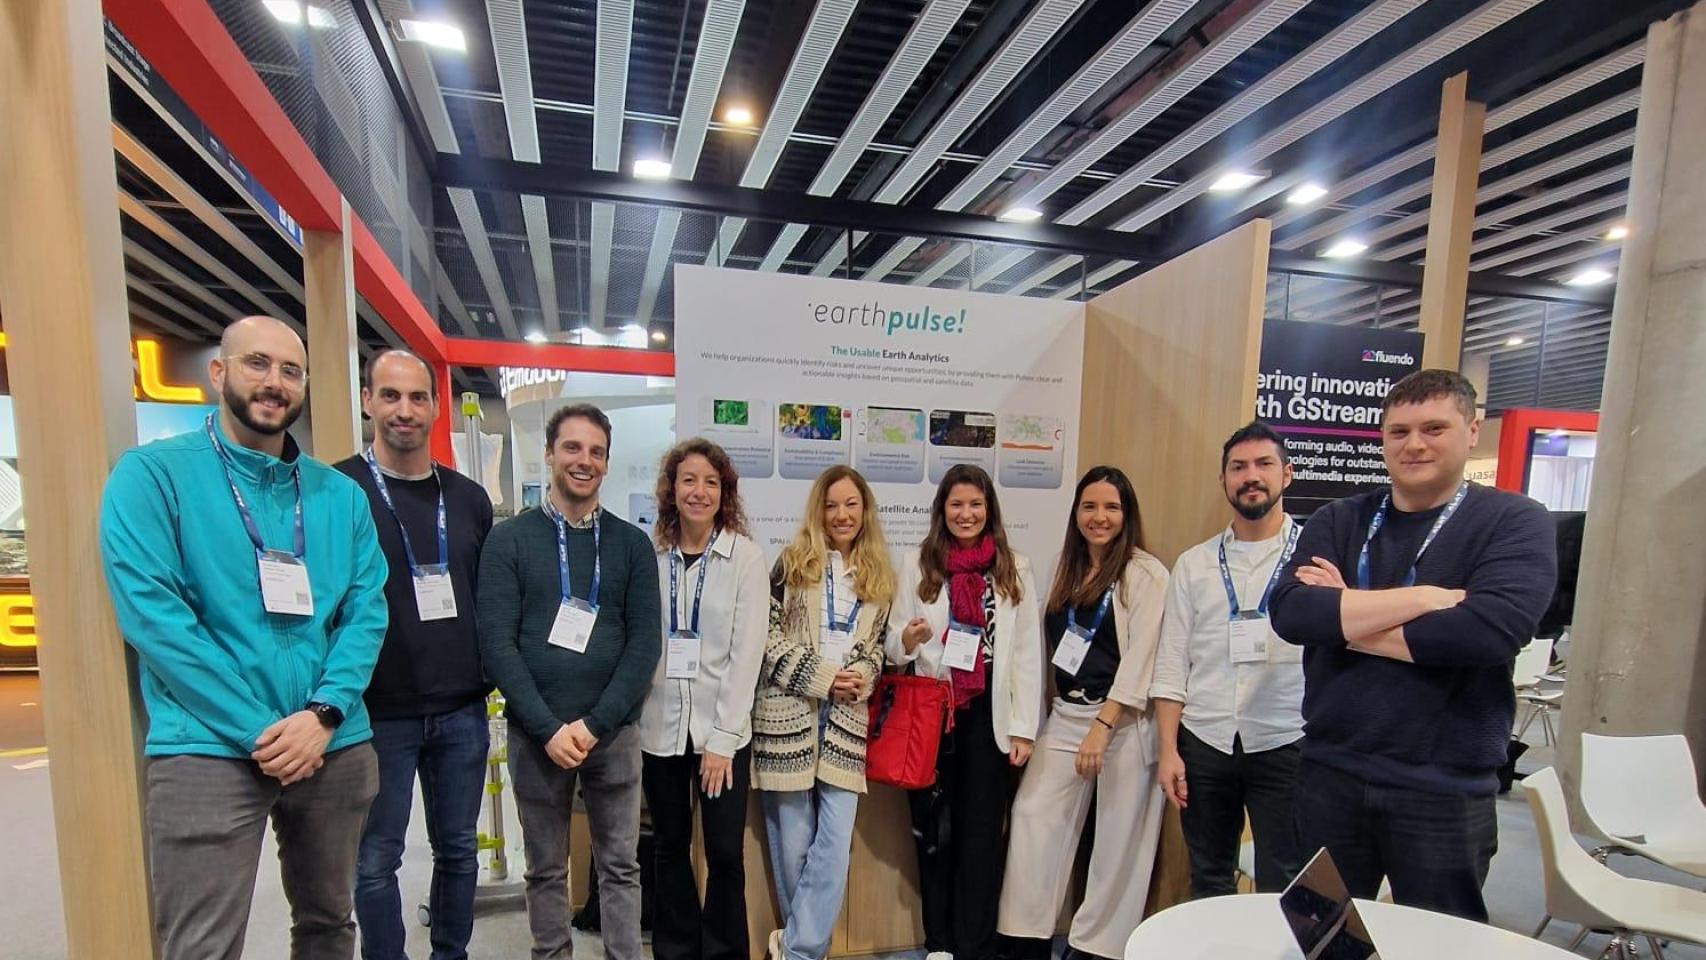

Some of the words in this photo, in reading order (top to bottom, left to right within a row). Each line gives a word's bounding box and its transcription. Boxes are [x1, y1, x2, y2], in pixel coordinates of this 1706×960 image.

[713, 352, 729, 362] help
[832, 346, 848, 356] The
[849, 347, 880, 358] Usable
[882, 349, 907, 360] Earth
[908, 351, 950, 363] Analytics
[1375, 350, 1414, 366] fluendo
[1325, 441, 1356, 454] audio,
[1330, 456, 1346, 467] for
[1346, 458, 1387, 470] outstan
